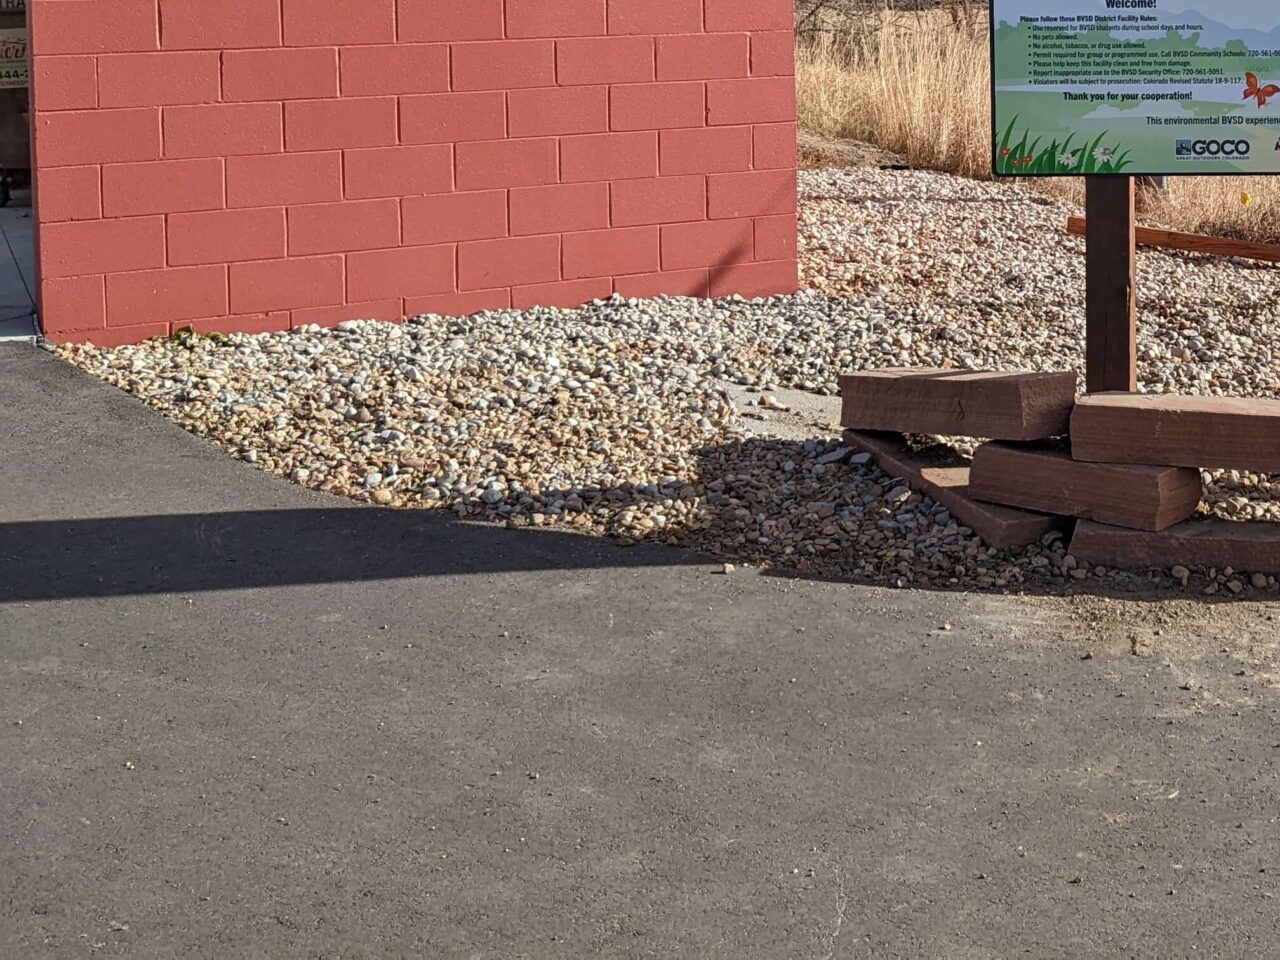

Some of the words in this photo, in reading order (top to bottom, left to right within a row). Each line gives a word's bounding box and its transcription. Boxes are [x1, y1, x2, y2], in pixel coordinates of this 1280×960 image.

[1063, 92, 1088, 100] Thank
[1090, 94, 1105, 102] you
[1107, 92, 1119, 100] for
[1120, 94, 1139, 102] your
[1141, 91, 1192, 101] cooperation!
[1146, 116, 1162, 125] This
[1164, 116, 1220, 125] environmental
[1222, 116, 1244, 124] BVSD
[1192, 140, 1250, 155] GOCO
